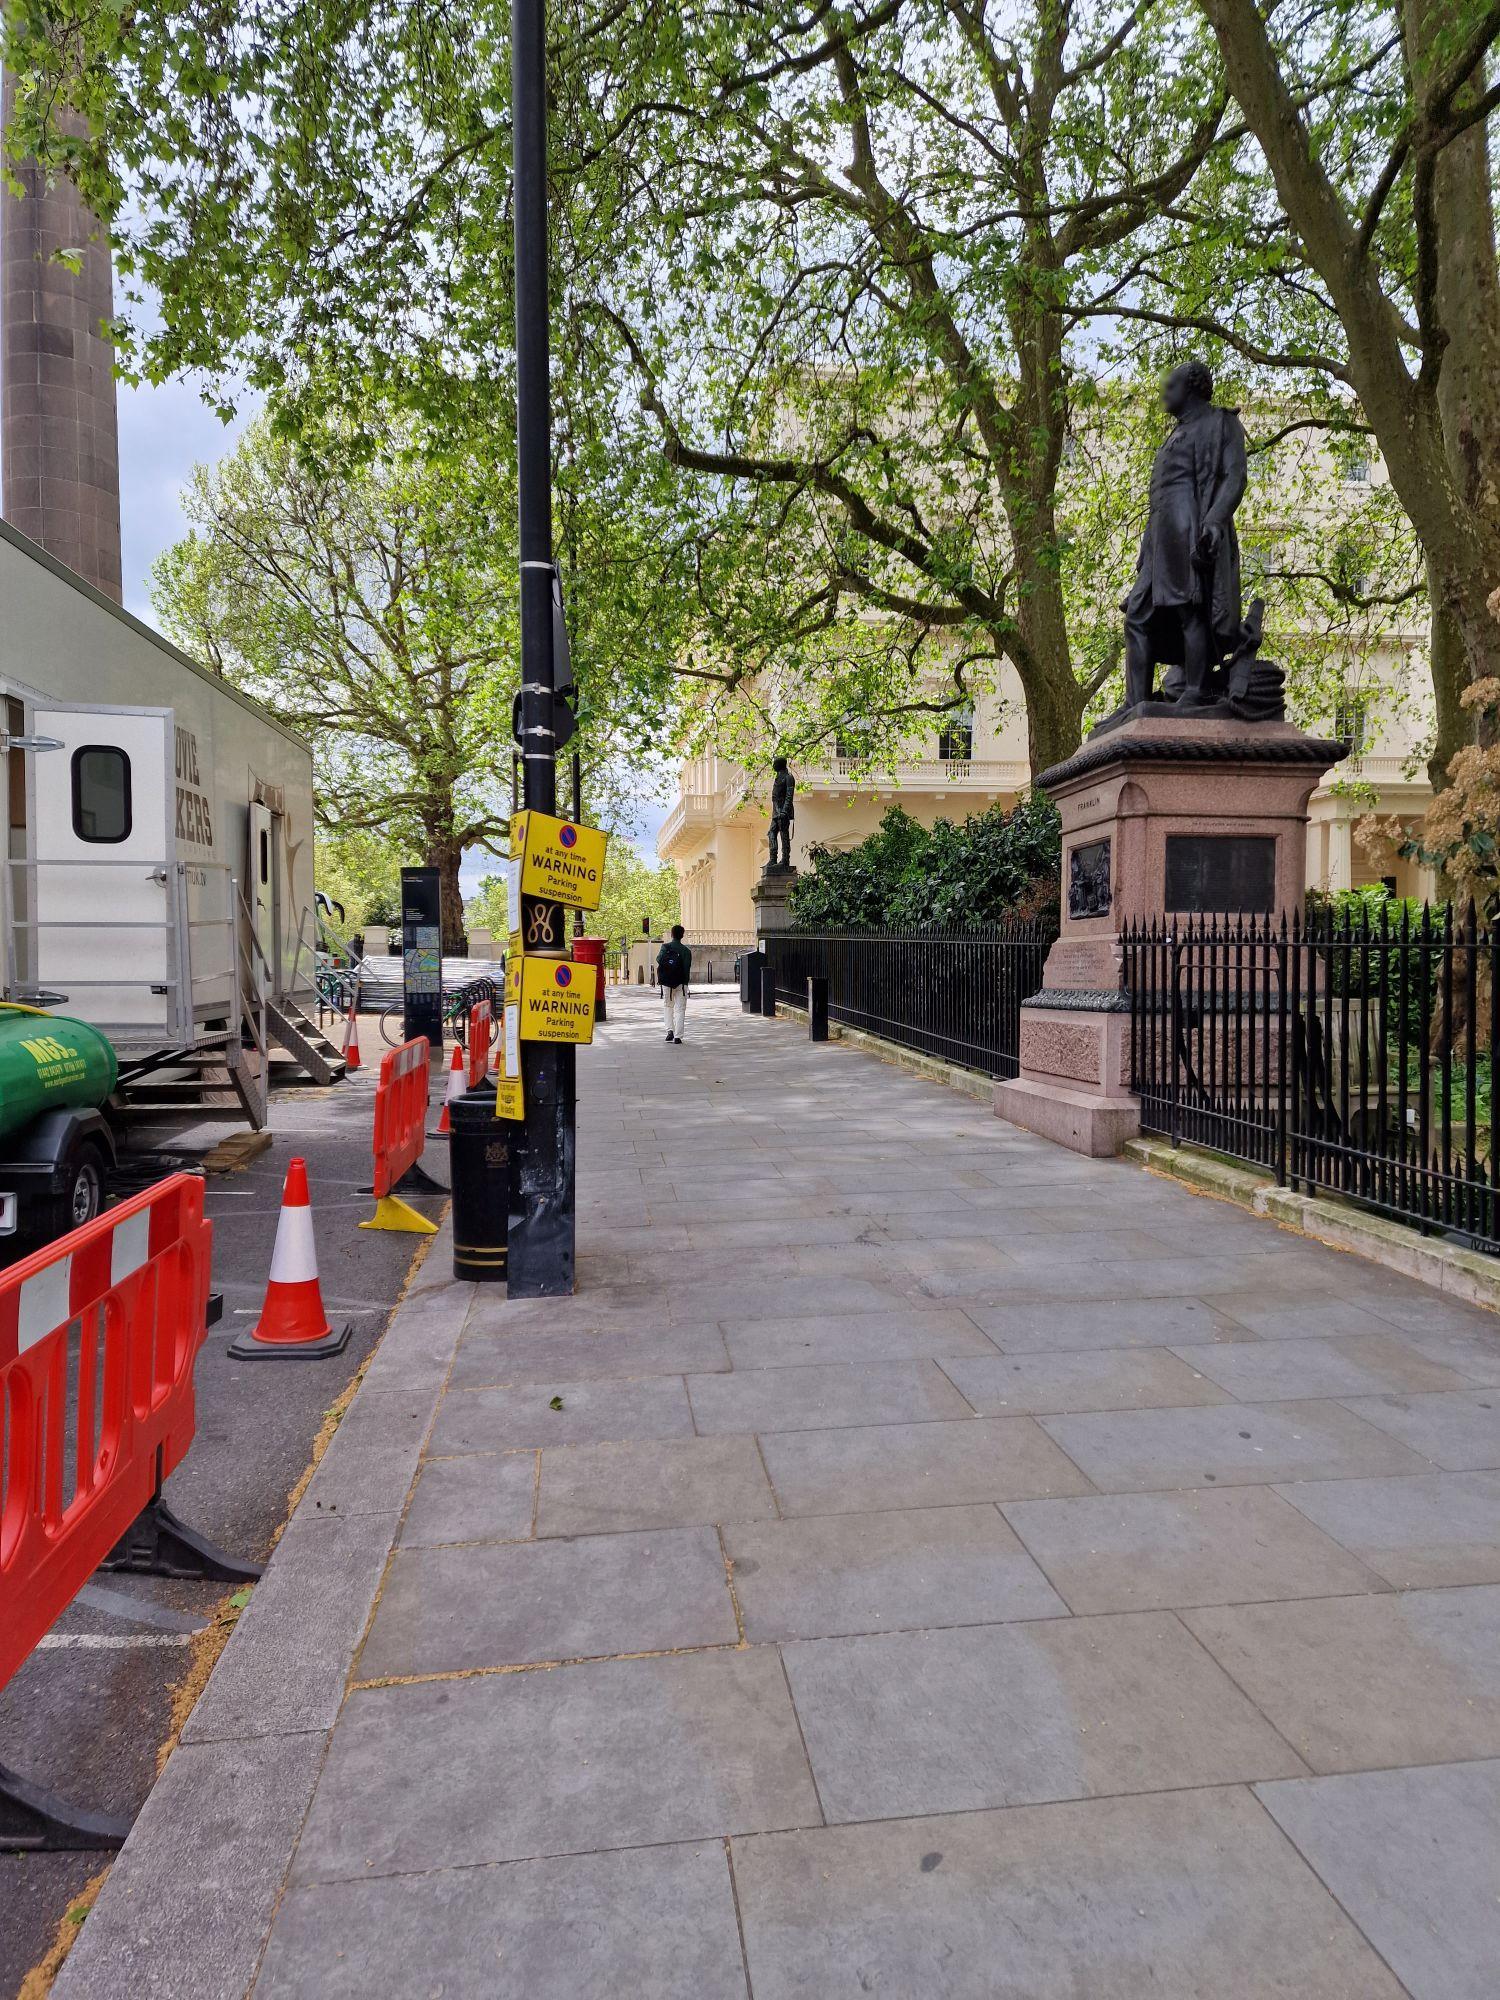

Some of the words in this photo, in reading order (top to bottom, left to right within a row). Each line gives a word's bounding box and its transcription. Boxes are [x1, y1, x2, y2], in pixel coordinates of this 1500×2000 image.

[174, 725, 200, 786] OVIE
[175, 786, 212, 847] KERS
[545, 847, 553, 855] at
[555, 850, 569, 862] any
[570, 852, 587, 864] time
[532, 853, 597, 882] WARNING
[547, 875, 578, 891] Parking
[538, 886, 583, 903] suspension
[542, 989, 550, 997] at
[552, 990, 565, 999] any
[566, 991, 581, 999] time
[529, 999, 590, 1016] WARNING
[546, 1017, 575, 1028] Parking
[538, 1029, 580, 1039] suspension
